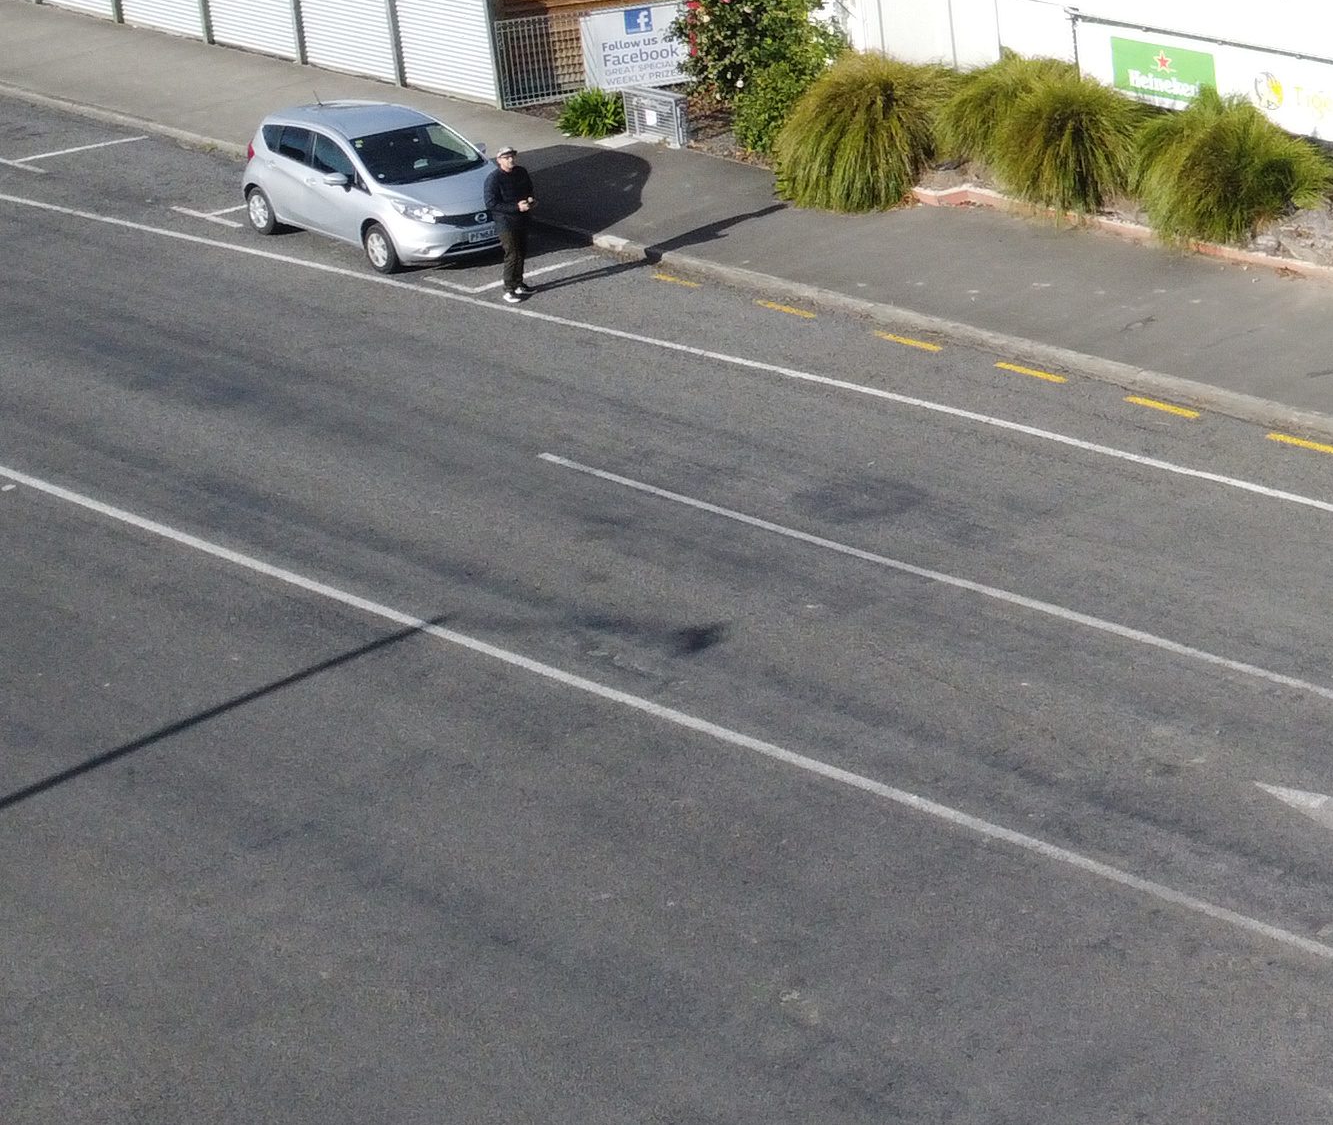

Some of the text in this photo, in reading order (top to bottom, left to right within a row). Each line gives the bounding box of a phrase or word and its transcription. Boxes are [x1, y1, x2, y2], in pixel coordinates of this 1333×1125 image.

[602, 38, 641, 52] Follow
[643, 35, 659, 46] us
[603, 43, 680, 68] Facebook
[604, 65, 635, 76] GREAT
[605, 74, 646, 86] WEEKLY
[1127, 68, 1201, 97] Heineken
